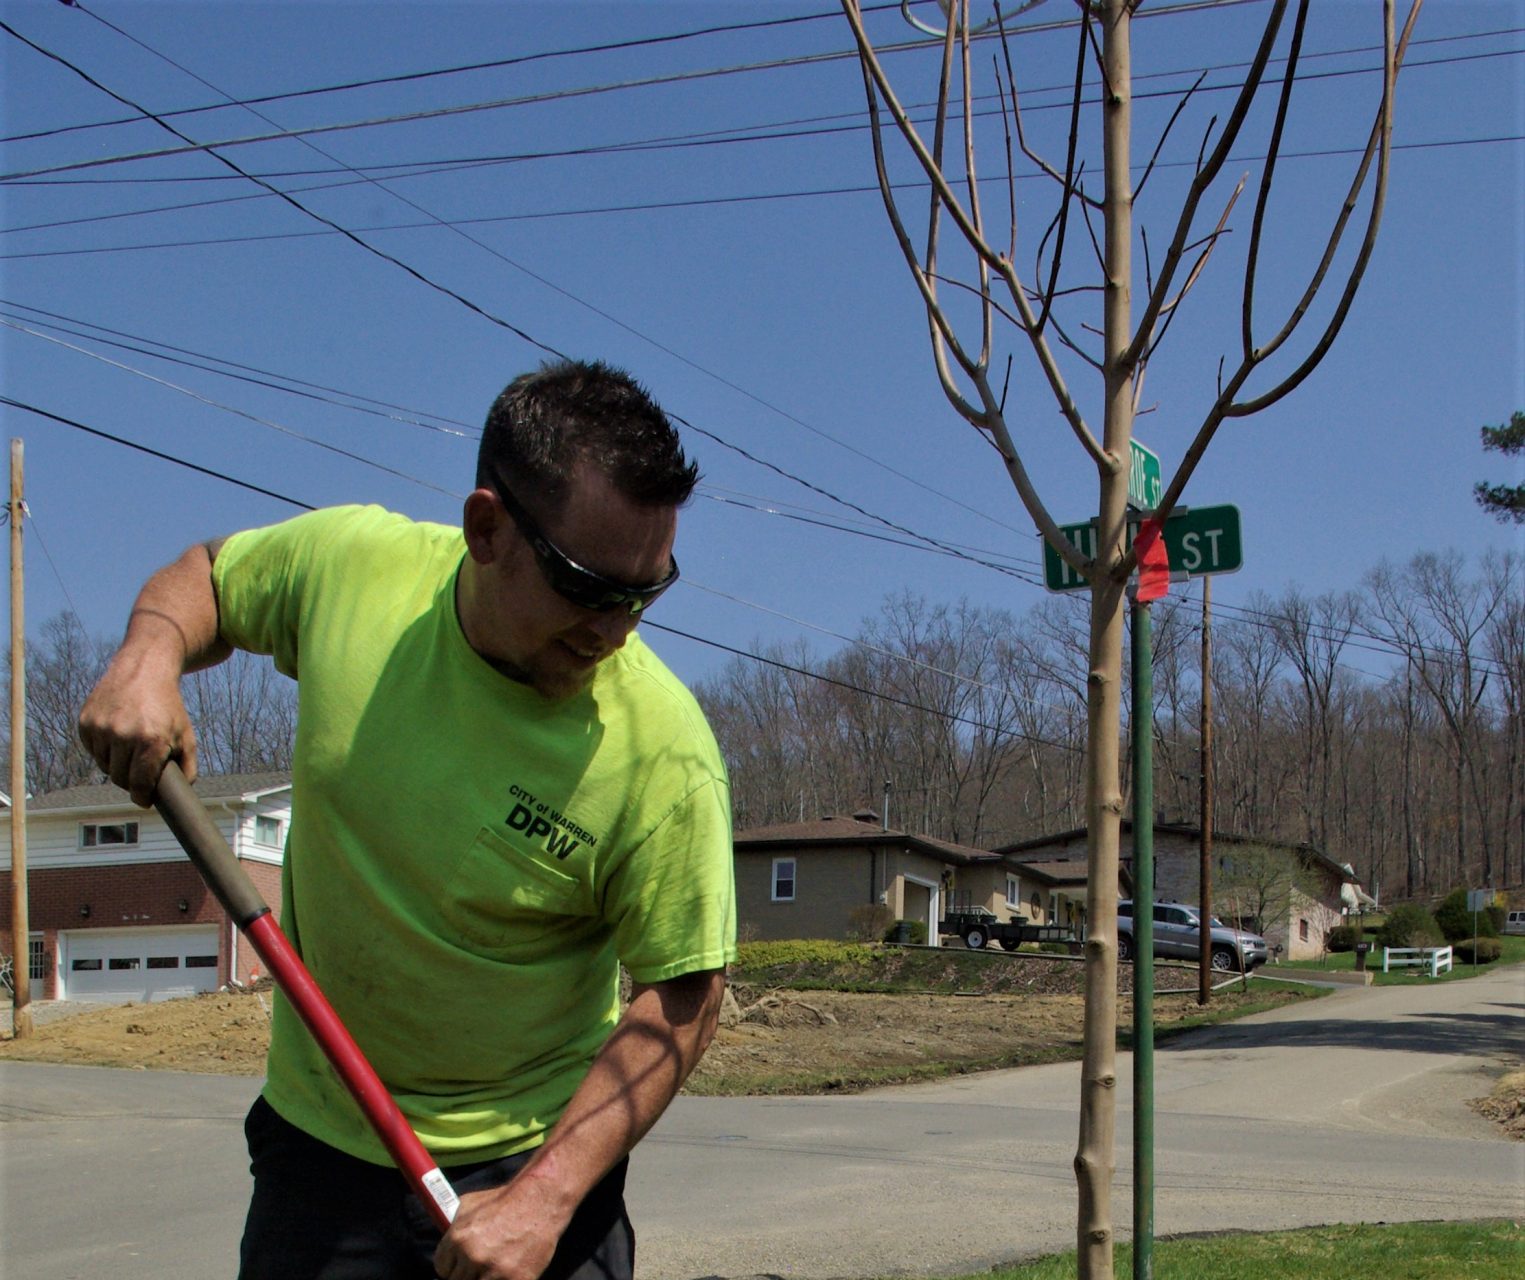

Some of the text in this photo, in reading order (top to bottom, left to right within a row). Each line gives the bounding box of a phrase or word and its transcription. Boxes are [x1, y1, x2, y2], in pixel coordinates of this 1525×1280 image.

[1182, 529, 1223, 569] ST
[505, 802, 580, 861] DPW
[509, 784, 598, 848] CITY of WARREN
